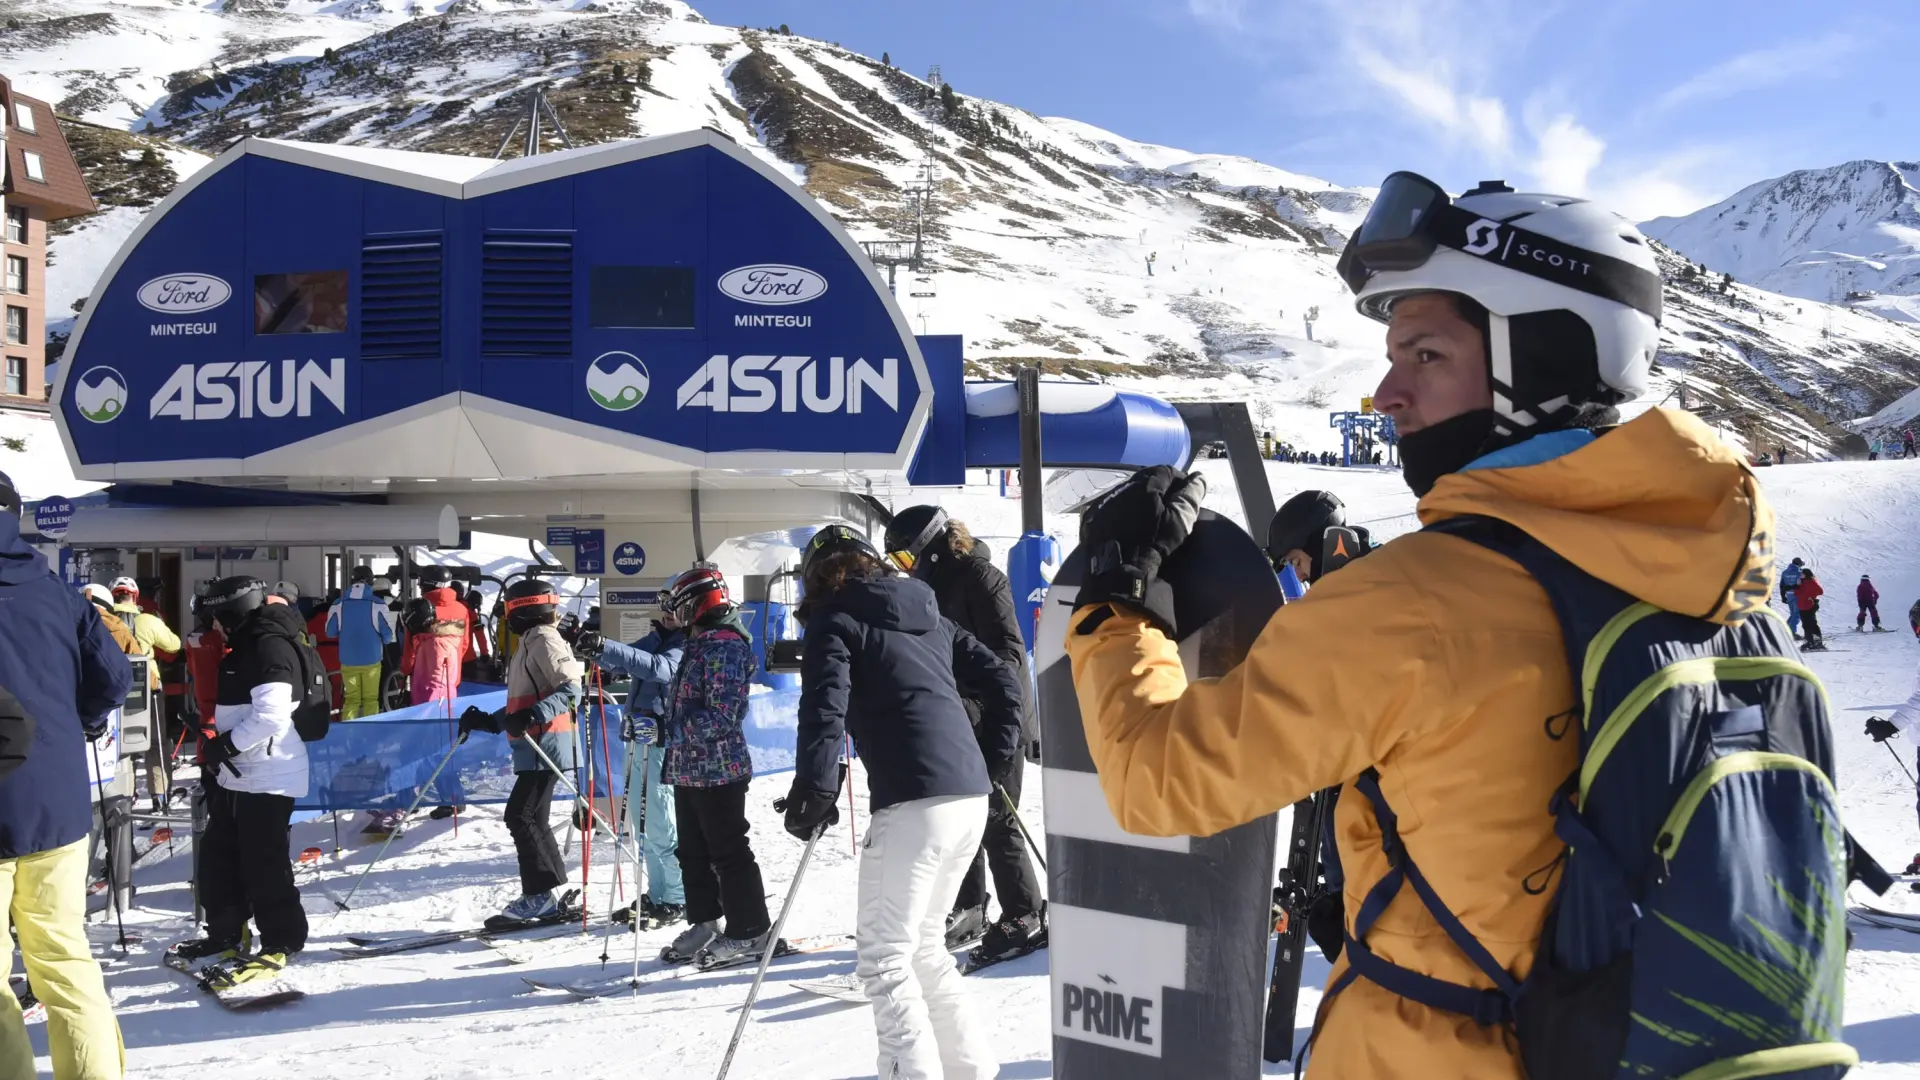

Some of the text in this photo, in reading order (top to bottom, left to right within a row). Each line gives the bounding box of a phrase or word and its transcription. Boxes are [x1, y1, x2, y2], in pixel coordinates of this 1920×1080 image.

[1518, 244, 1592, 275] SCOTT
[157, 280, 211, 305] Ford
[741, 270, 805, 296] Ford
[150, 322, 217, 336] MINTEGUI
[735, 314, 812, 328] MINTEGUI
[149, 357, 346, 421] ASTUN
[676, 354, 899, 414] ASTUN
[40, 504, 70, 514] FILA DE
[616, 557, 643, 565] ASTUN
[617, 596, 655, 605] Doppelmayr
[1062, 982, 1153, 1046] PRIME
